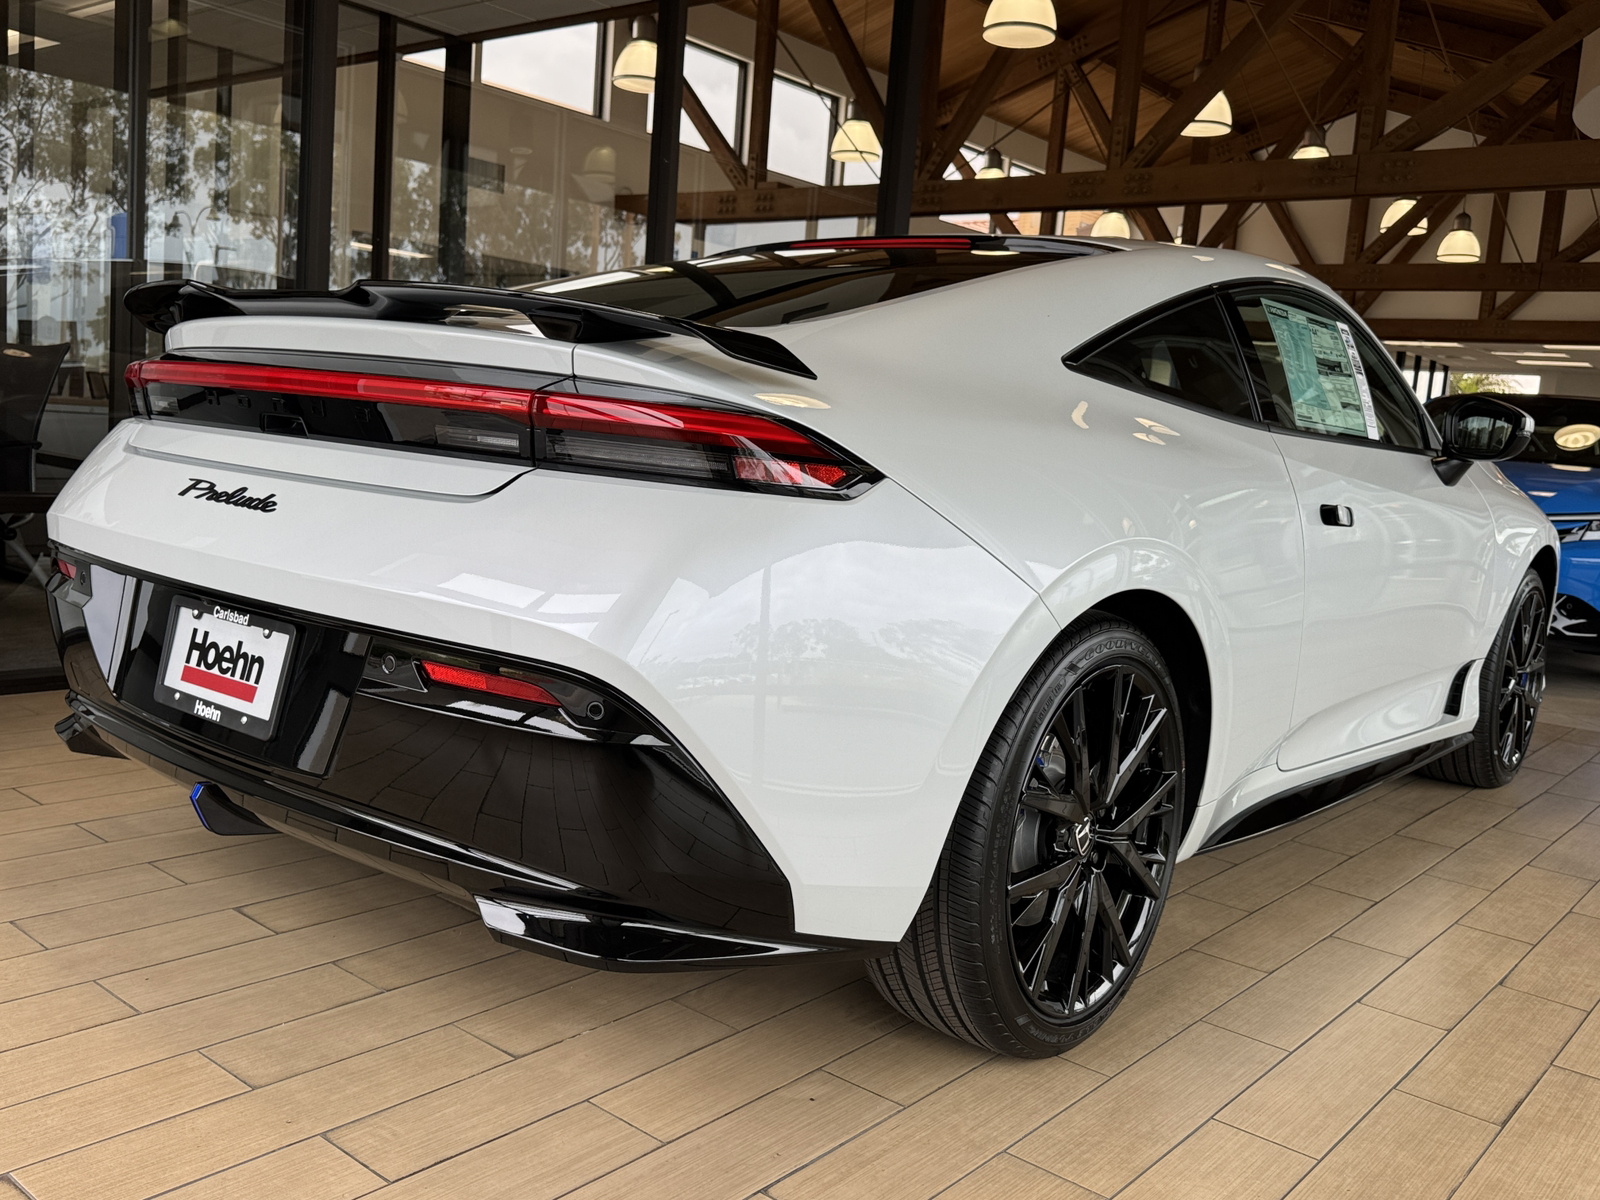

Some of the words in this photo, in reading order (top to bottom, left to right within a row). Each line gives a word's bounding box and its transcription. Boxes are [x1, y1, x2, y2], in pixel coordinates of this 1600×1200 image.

[178, 478, 278, 513] Prelude
[213, 605, 249, 626] Carlsbad
[185, 627, 265, 685] Hoehn
[194, 699, 221, 722] Hoehn
